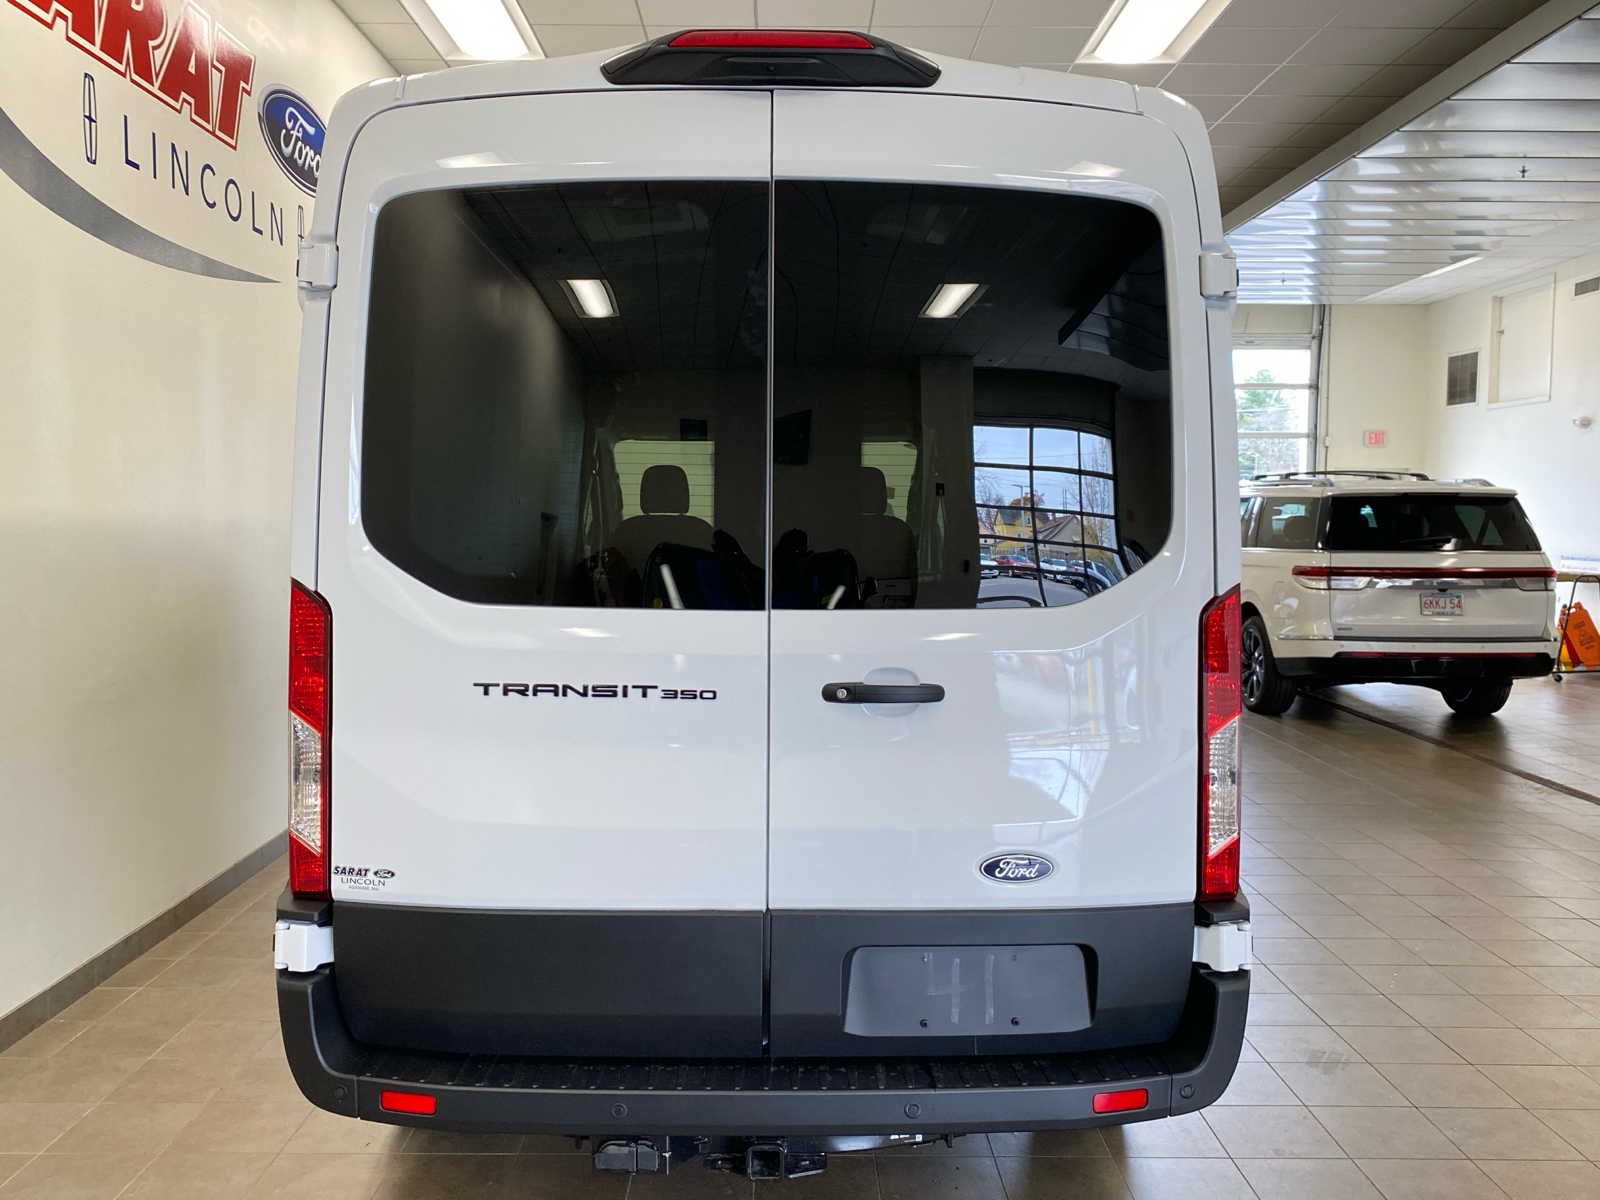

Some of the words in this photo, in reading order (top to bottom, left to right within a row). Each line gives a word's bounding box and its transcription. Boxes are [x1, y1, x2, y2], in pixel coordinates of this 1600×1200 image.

[124, 114, 283, 246] LINCOLN
[1368, 431, 1386, 445] EXIT
[1450, 599, 1461, 609] 54
[333, 866, 370, 877] SARAT
[995, 859, 1039, 878] Ford
[341, 877, 386, 886] LINCOLN
